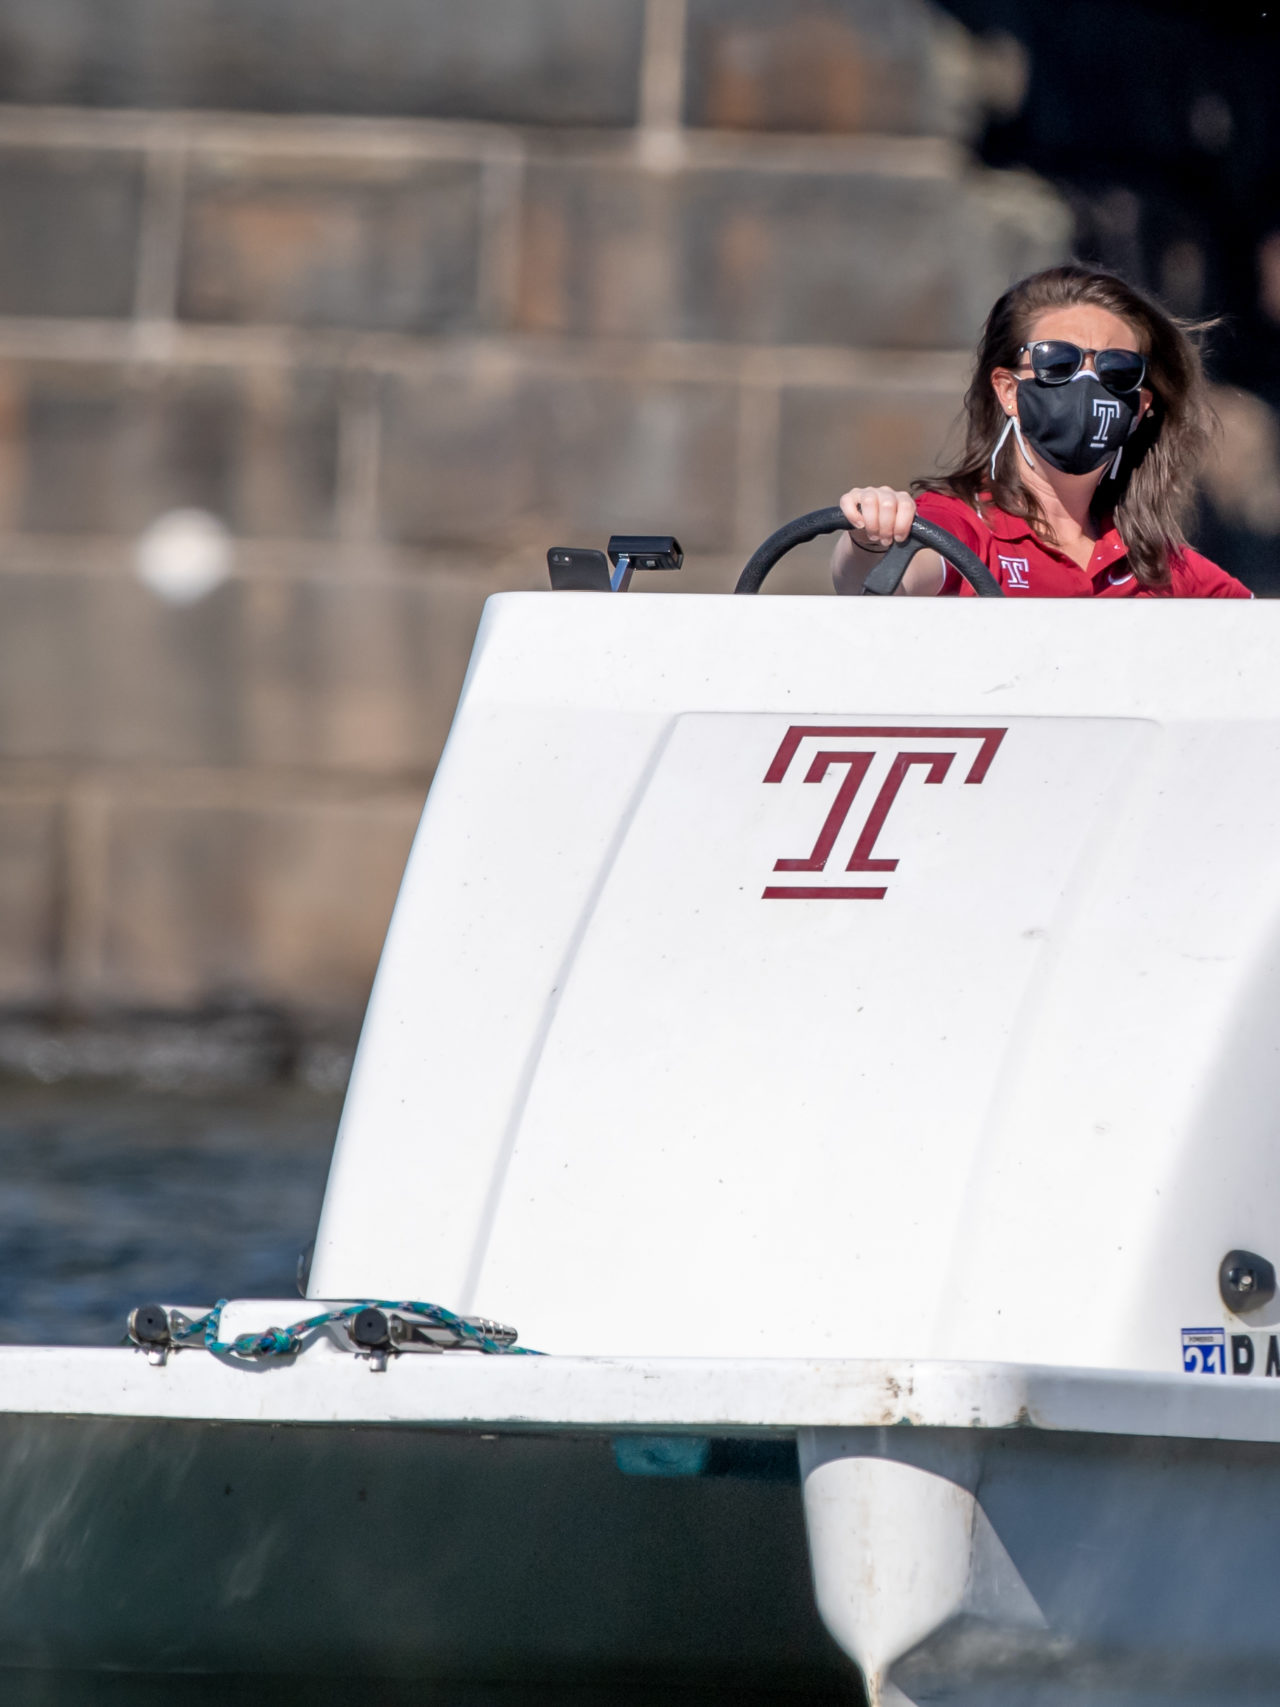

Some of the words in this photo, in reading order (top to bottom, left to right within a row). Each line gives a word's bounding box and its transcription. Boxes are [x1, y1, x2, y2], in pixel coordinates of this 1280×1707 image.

[1089, 398, 1121, 448] T
[998, 554, 1030, 589] T
[761, 725, 1009, 900] T
